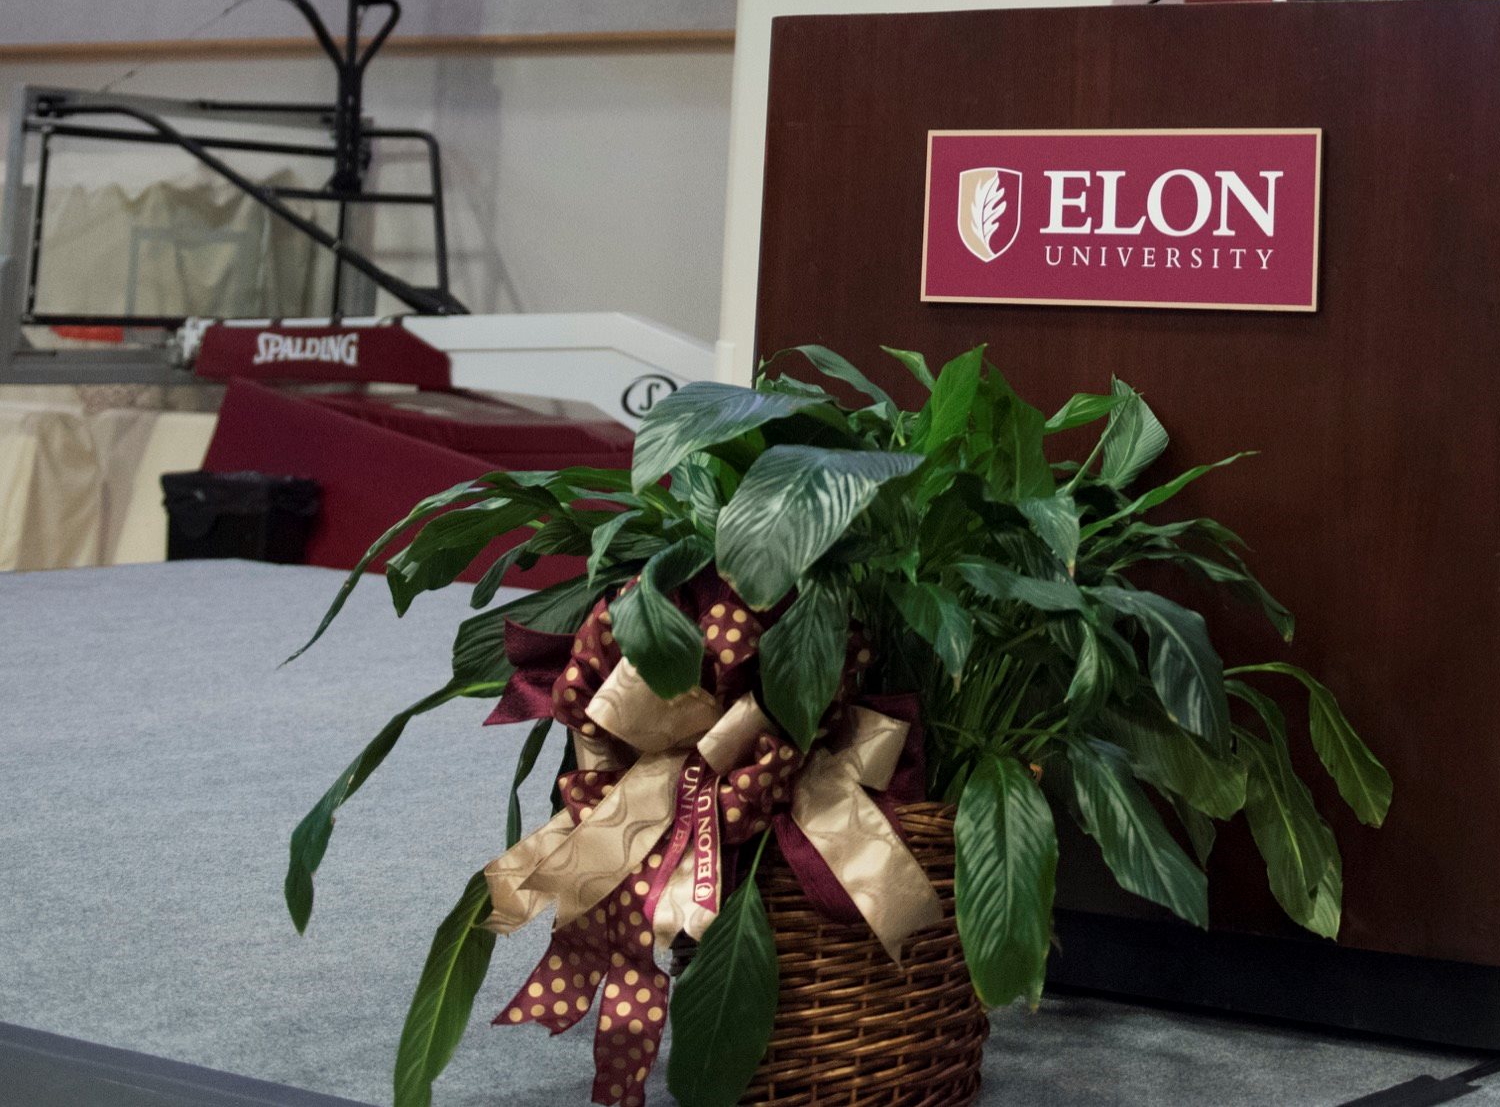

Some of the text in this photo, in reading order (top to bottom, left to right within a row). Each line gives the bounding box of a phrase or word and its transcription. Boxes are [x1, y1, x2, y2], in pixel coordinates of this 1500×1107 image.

[1040, 169, 1284, 238] ELON
[1045, 245, 1274, 269] UNIVERSITY
[253, 332, 359, 366] SPALDING
[697, 816, 712, 880] ELON
